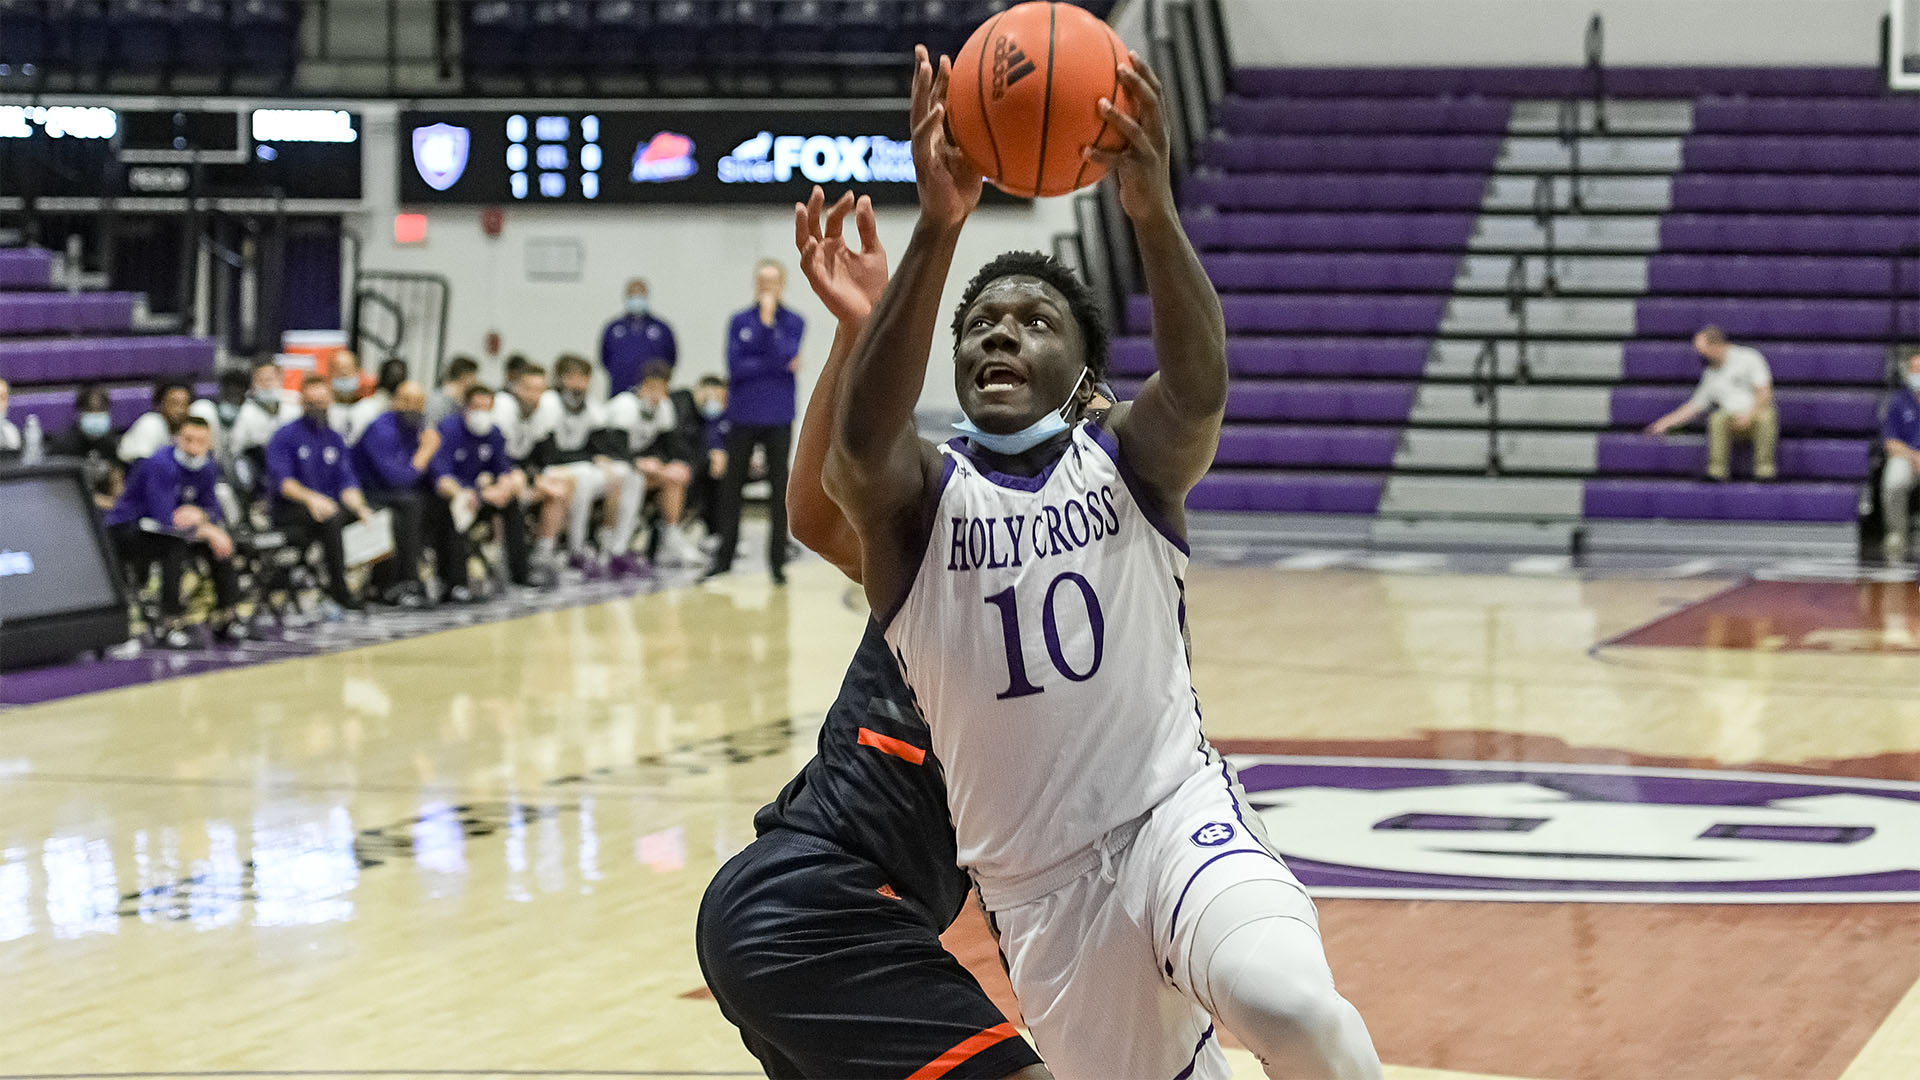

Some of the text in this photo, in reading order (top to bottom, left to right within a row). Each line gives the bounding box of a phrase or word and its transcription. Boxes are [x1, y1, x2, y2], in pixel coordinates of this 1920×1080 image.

[773, 135, 872, 183] FOX
[948, 485, 1120, 571] HOLY CROSS
[984, 571, 1105, 701] 10
